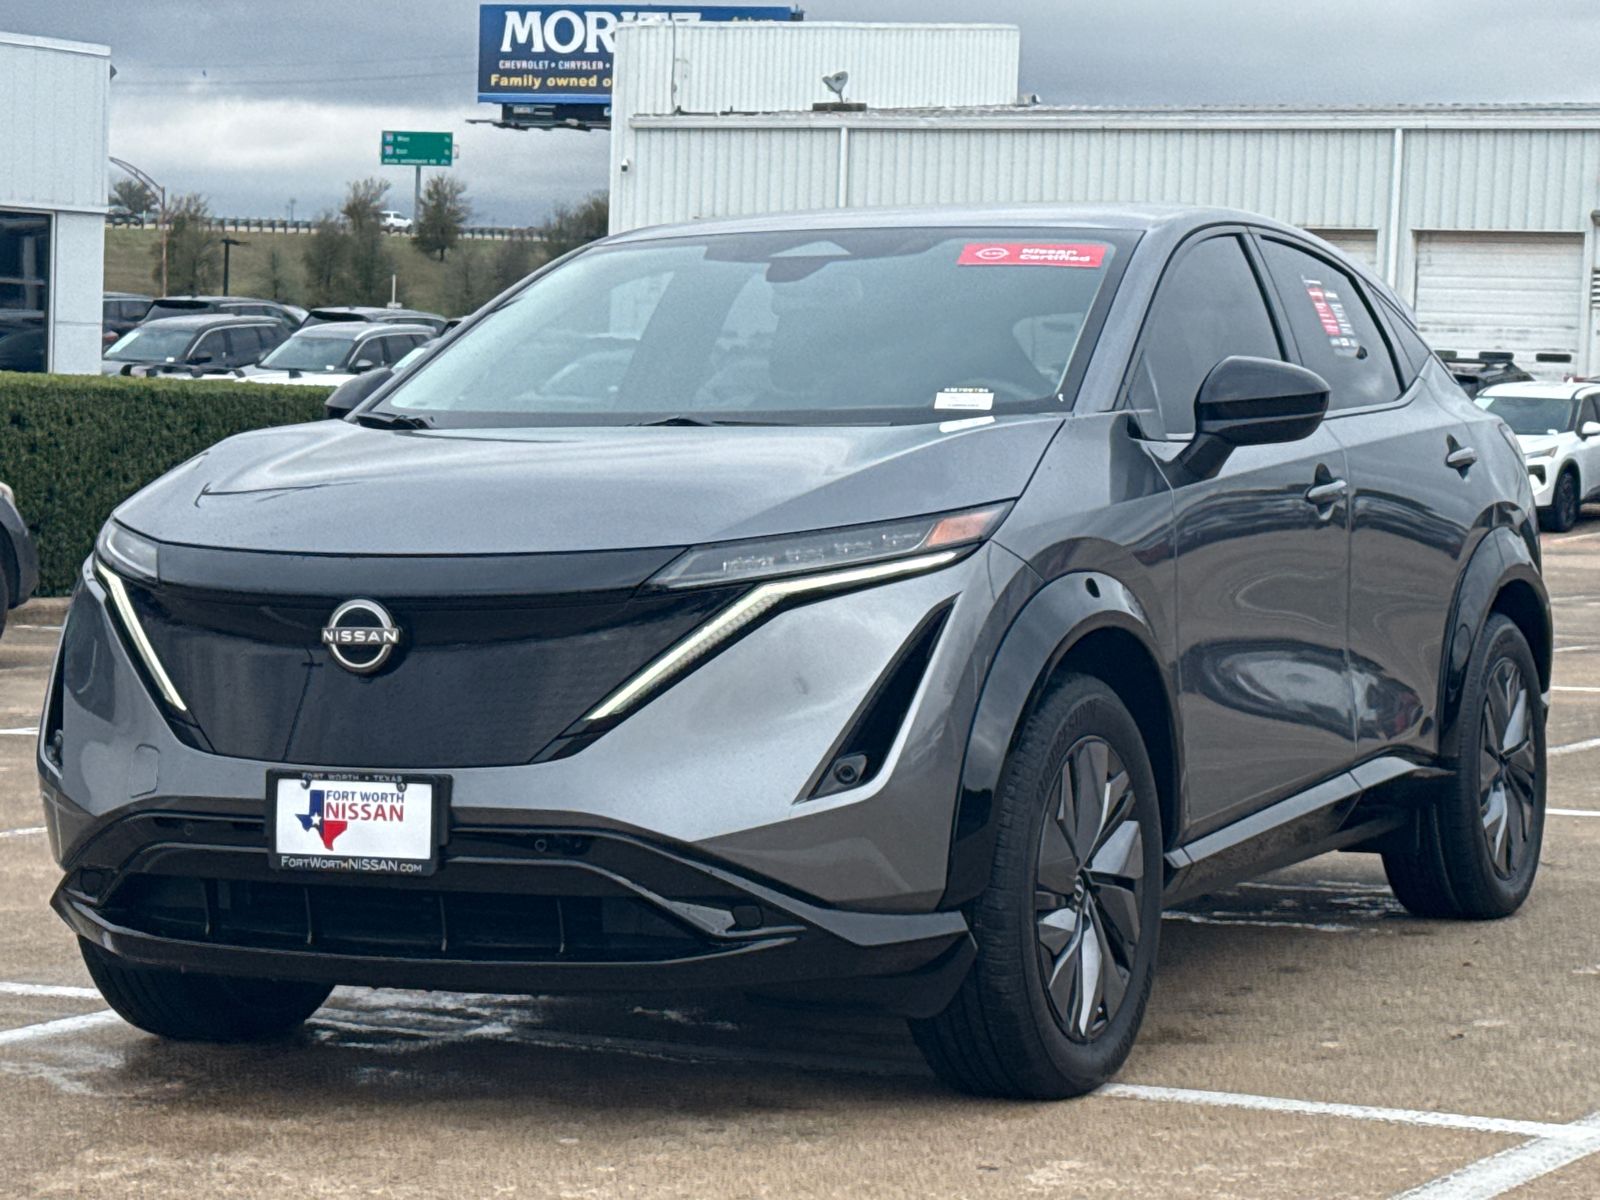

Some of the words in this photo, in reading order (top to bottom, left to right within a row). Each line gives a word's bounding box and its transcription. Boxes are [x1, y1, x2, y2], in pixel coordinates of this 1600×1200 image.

[499, 60, 549, 70] CHEVROLET
[558, 60, 603, 70] CHRYSLER
[490, 74, 542, 89] Family
[546, 75, 598, 87] owned
[1019, 254, 1091, 262] Certified
[323, 630, 397, 643] NISSAN
[302, 773, 324, 781] FORT
[373, 774, 403, 782] TEXAS
[326, 790, 357, 801] FORT
[360, 791, 405, 804] WORTH
[326, 802, 404, 822] NISSAN
